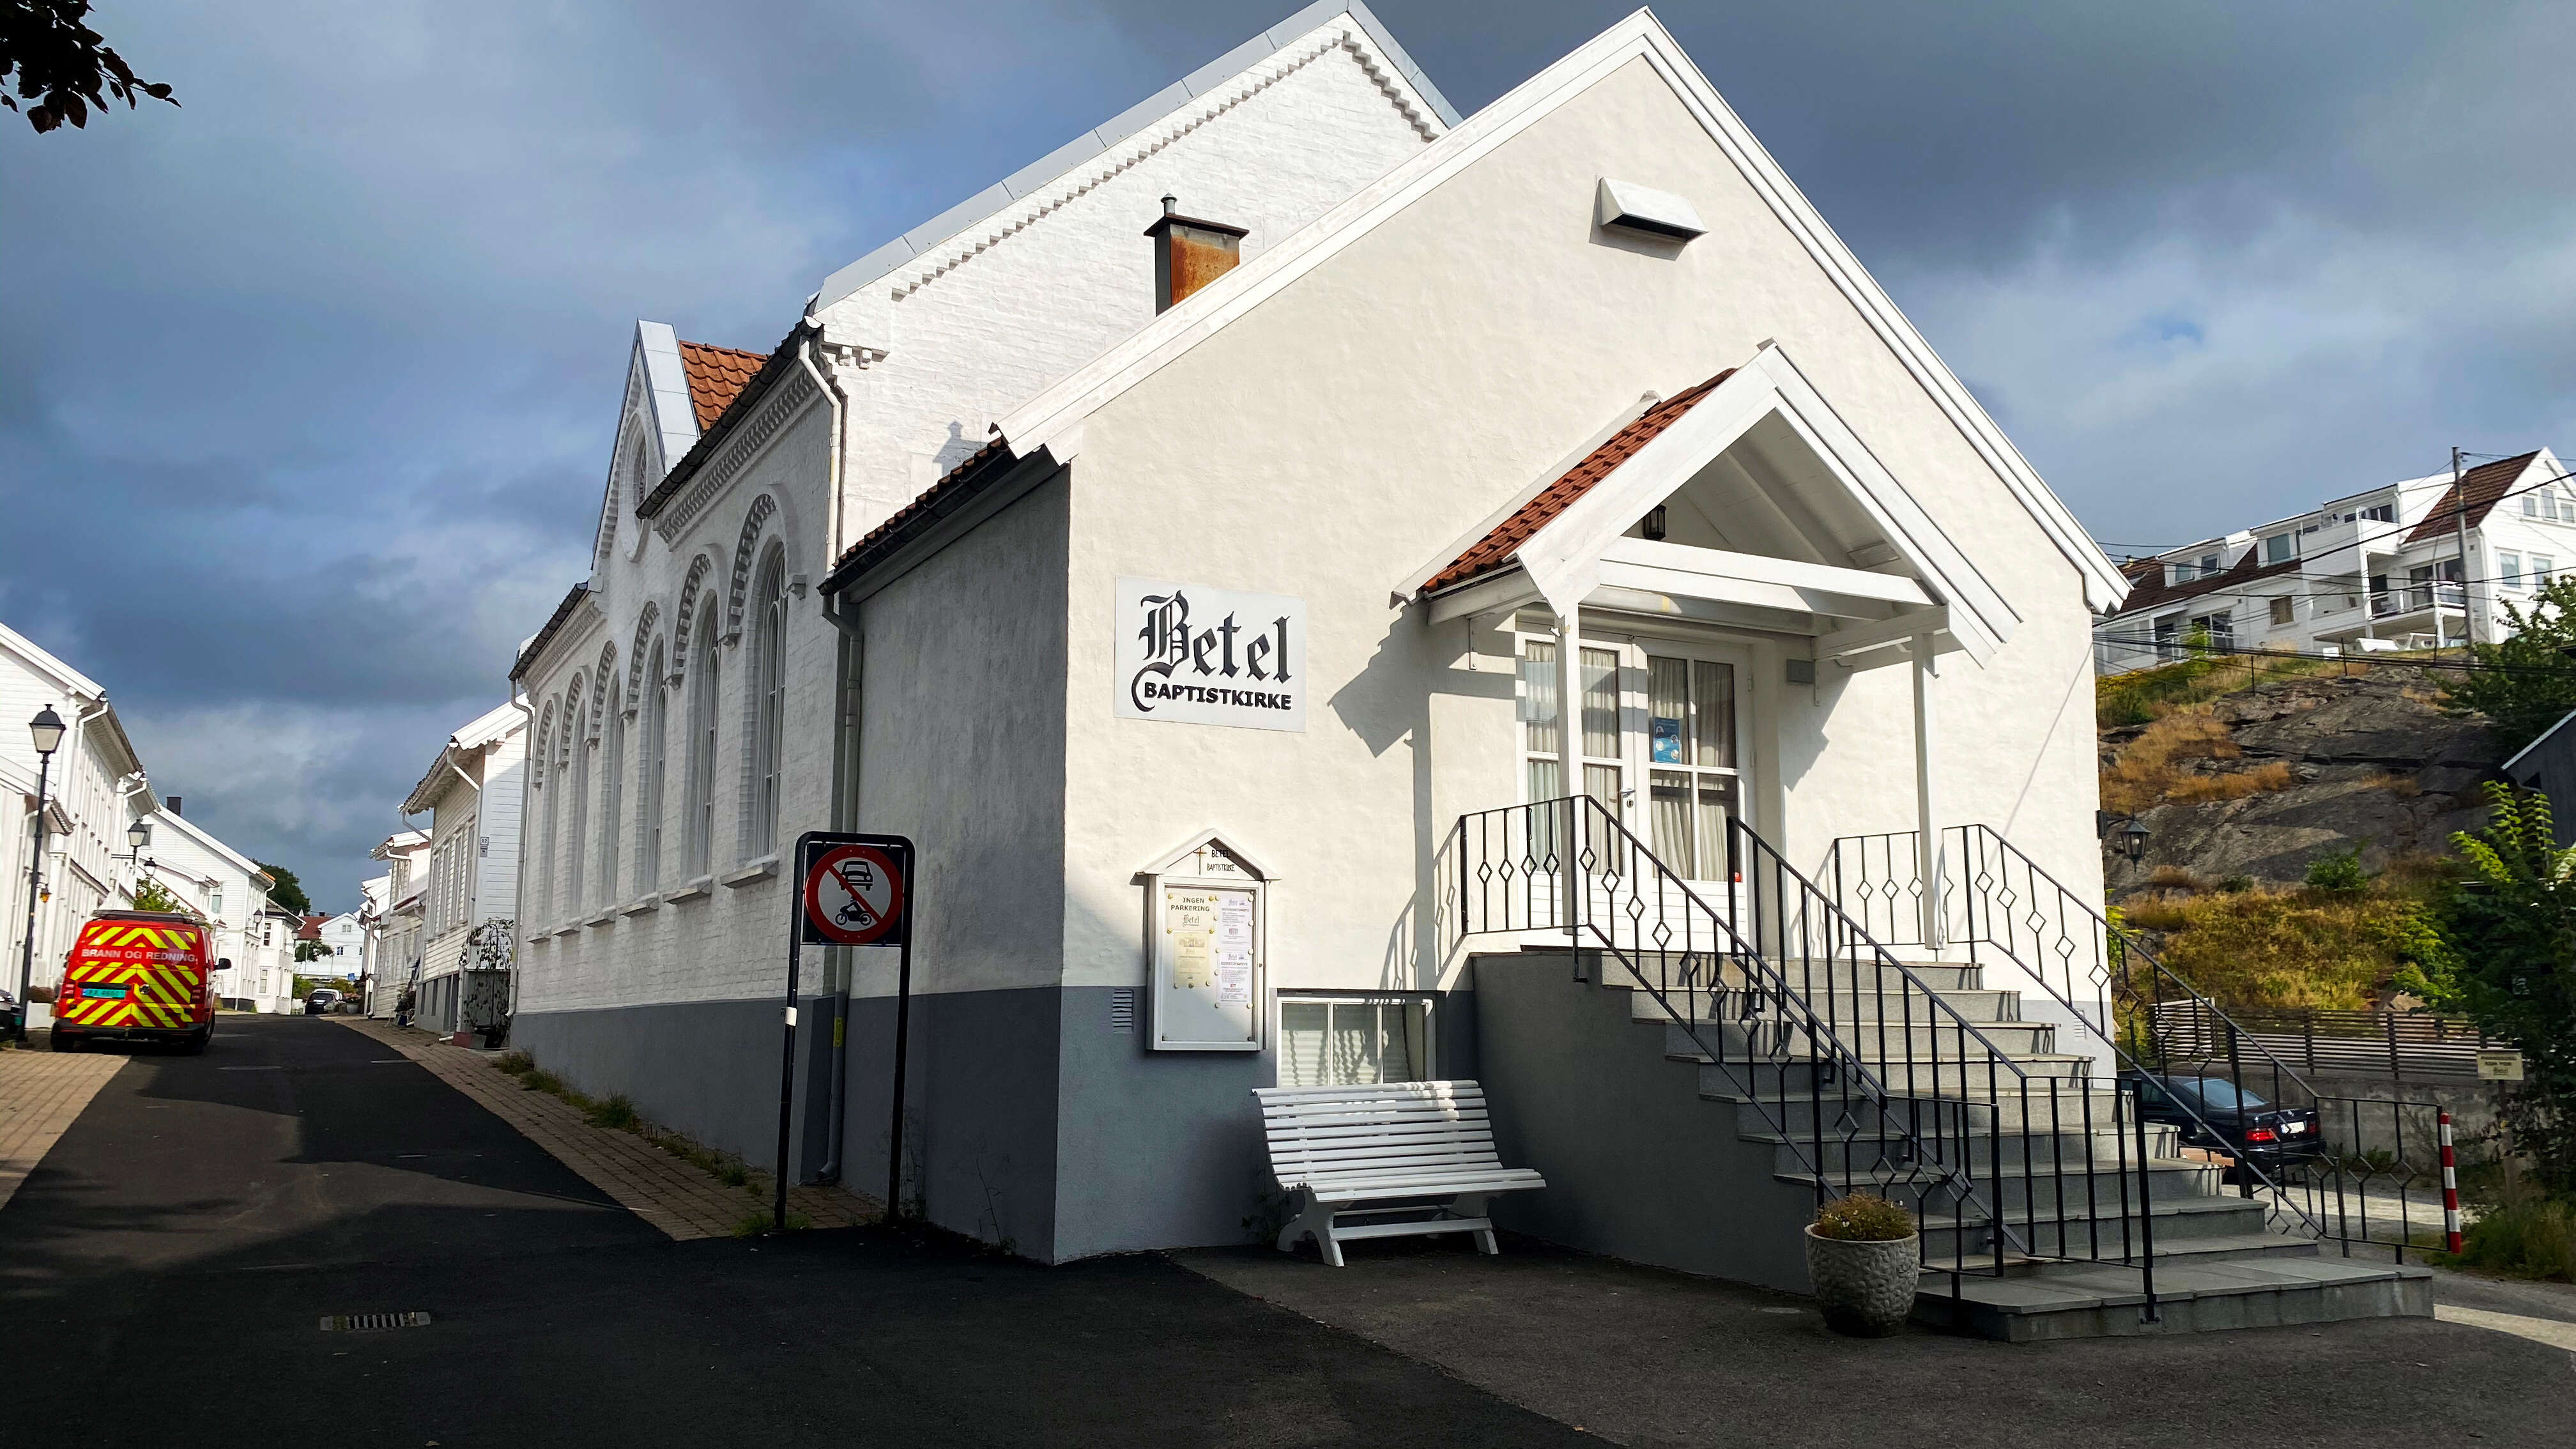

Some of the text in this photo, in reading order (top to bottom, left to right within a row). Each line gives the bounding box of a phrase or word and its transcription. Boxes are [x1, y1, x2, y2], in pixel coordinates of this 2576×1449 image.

[1131, 590, 1292, 712] Betel
[1144, 682, 1292, 710] BAPTISTKIRKE
[1211, 849, 1230, 858] BETEL
[81, 949, 195, 962] BRANN OG REDNING
